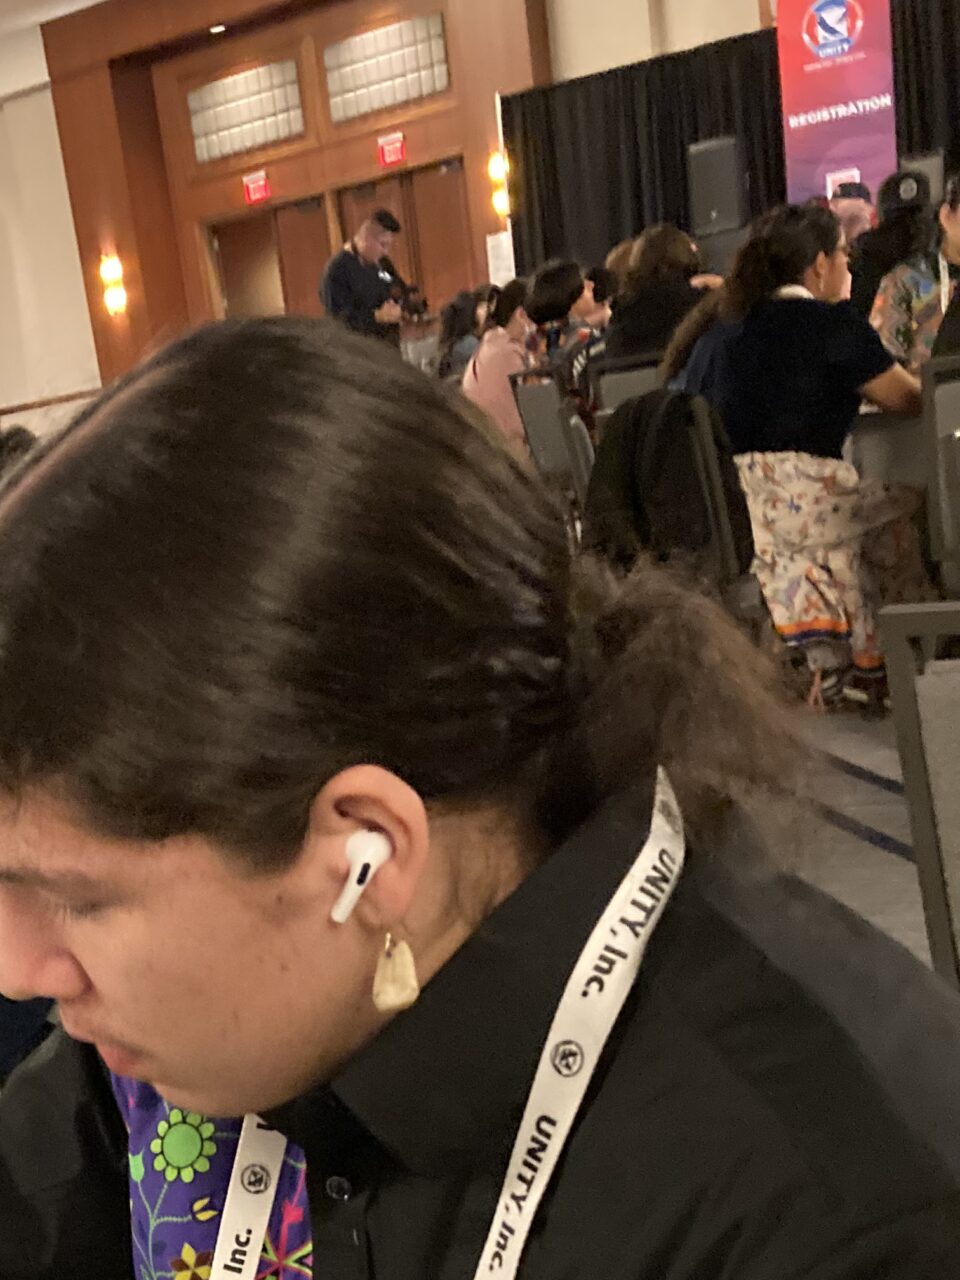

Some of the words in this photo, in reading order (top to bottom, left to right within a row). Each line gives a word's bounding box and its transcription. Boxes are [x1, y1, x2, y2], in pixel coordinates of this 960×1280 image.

[789, 93, 891, 128] REGISTRATION
[608, 847, 677, 940] UNITY,
[581, 944, 628, 999] Inc.
[504, 1114, 557, 1215] UNITY,
[223, 1227, 252, 1276] Inc.
[488, 1219, 515, 1273] Inc.
